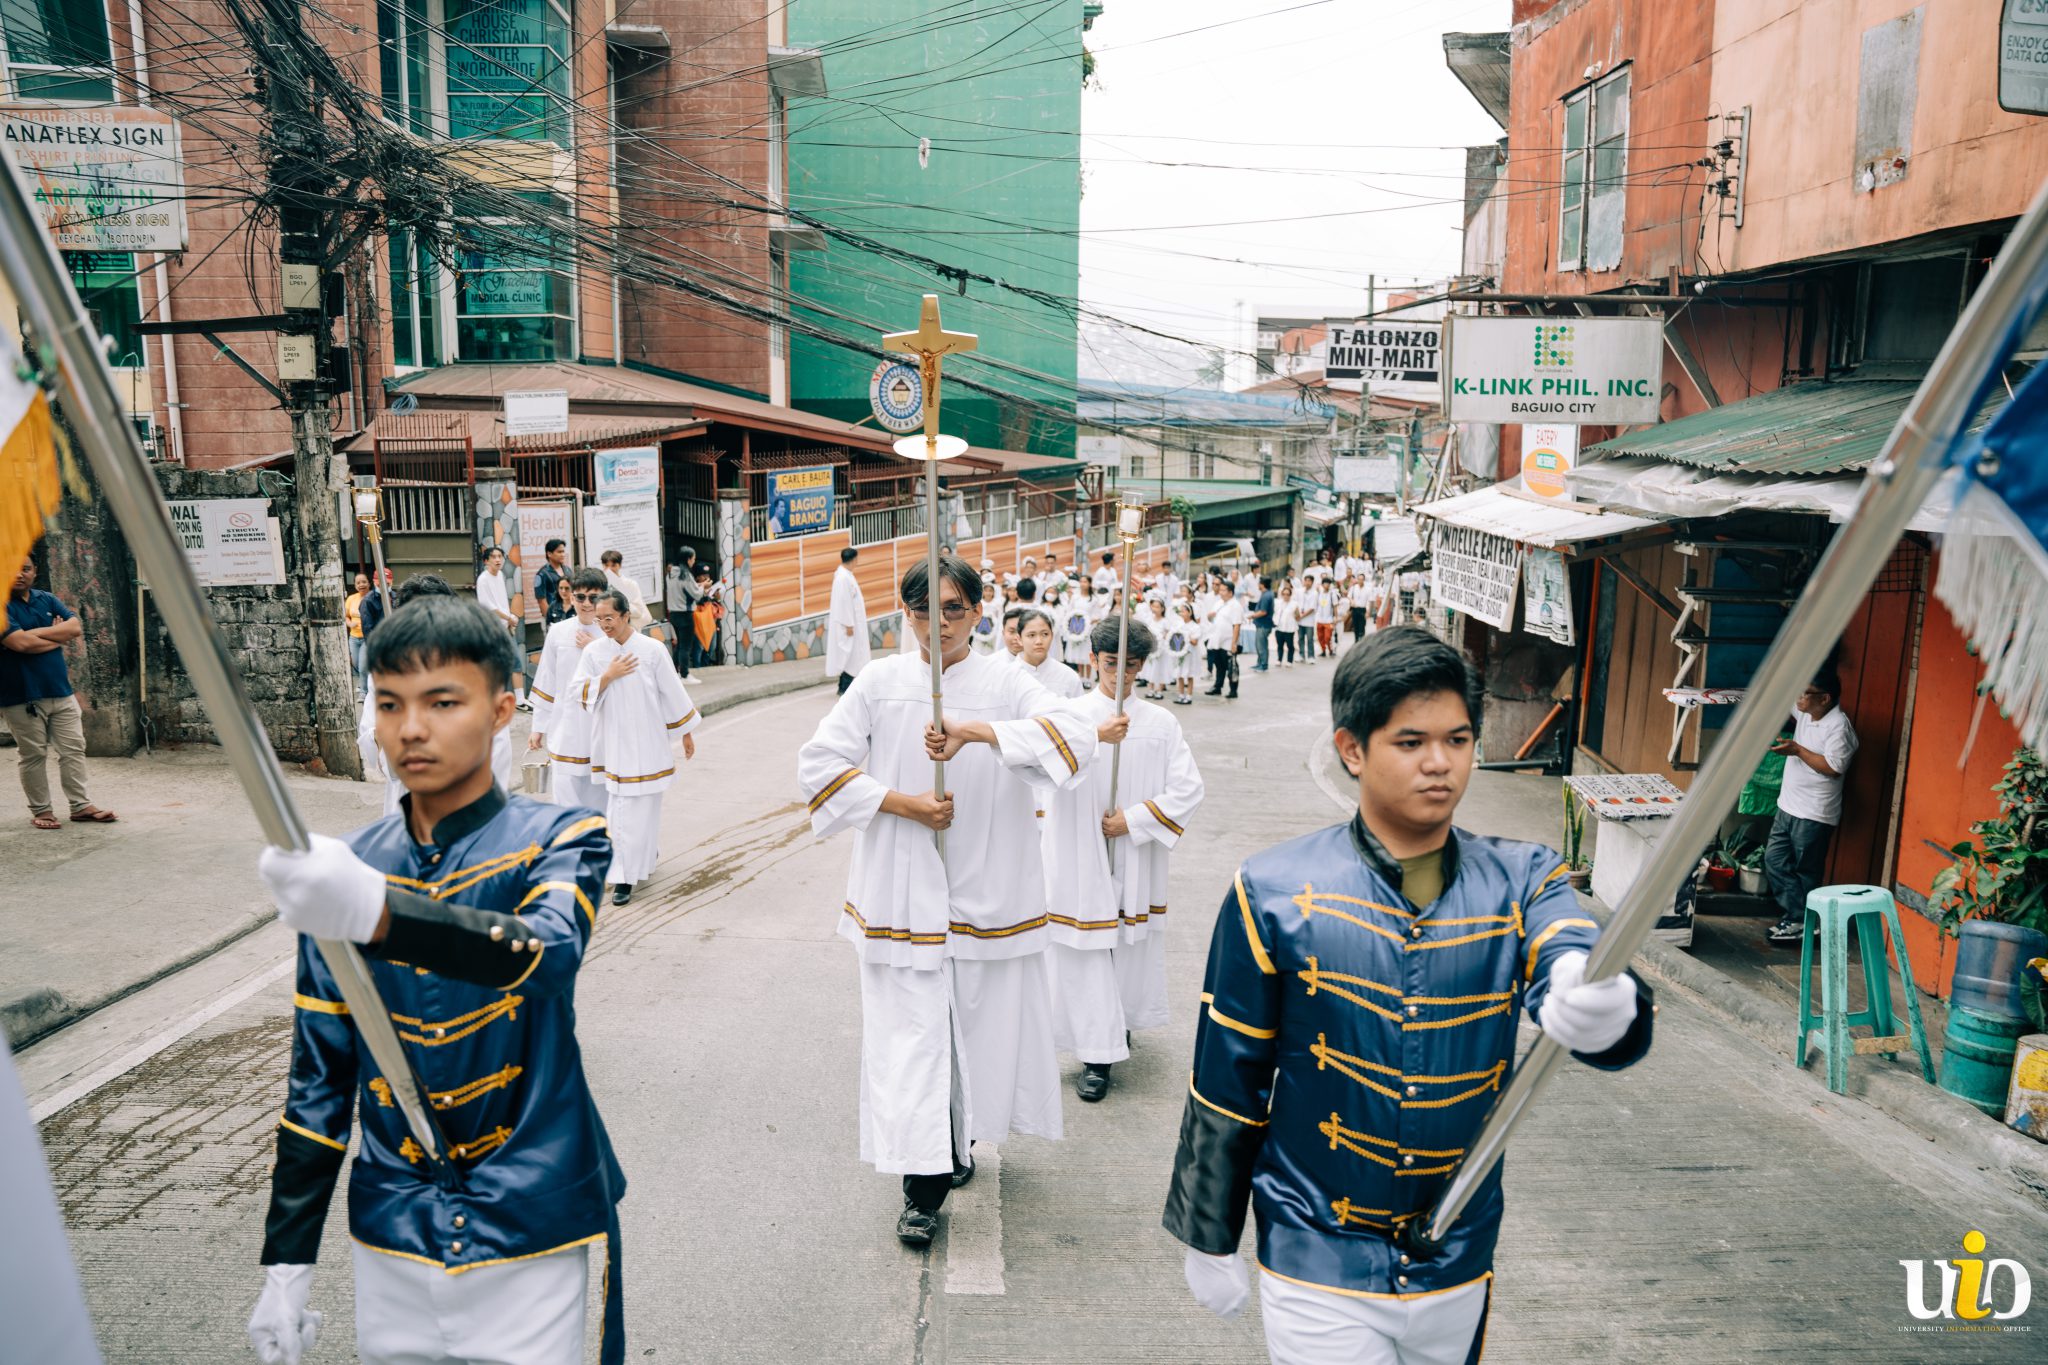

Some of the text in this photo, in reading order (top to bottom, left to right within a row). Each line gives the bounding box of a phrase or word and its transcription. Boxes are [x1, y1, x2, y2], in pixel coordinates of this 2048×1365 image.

[471, 14, 516, 28] HOUSE
[460, 29, 529, 44] CHRISTIAN
[2006, 34, 2041, 50] ENJOY
[472, 47, 519, 62] CENTER
[2006, 48, 2032, 62] DATA
[457, 62, 536, 77] WORLDWIDE
[112, 127, 164, 146] SIGN
[15, 150, 143, 163] T-SHIRT PRINTING
[62, 213, 131, 227] STAINLESS
[135, 213, 170, 227] SIGN
[471, 292, 542, 304] MEDICAL CLINIC
[1332, 328, 1438, 347] T-ALONZO
[1329, 349, 1438, 369] MINI-MART
[1359, 369, 1406, 381] 24/7
[1453, 377, 1654, 397] K-LINK PHIL. INC.
[1511, 402, 1597, 414] BAGUIO CITY
[1536, 429, 1559, 446] EATERY
[618, 467, 639, 476] Dental
[782, 474, 800, 485] CARL
[789, 495, 827, 512] BAGUIO
[520, 511, 566, 531] Herald
[789, 509, 828, 528] BRANCH
[185, 534, 205, 549] DITO!
[1481, 531, 1520, 569] EATERY
[1441, 552, 1456, 569] SERVE
[1456, 556, 1477, 575] BUDGET
[1444, 569, 1459, 586] SERVE
[1440, 584, 1447, 598] WE
[1447, 585, 1463, 604] SERVE
[976, 617, 994, 634] A
[1068, 614, 1086, 634] M
[1170, 634, 1186, 651] Y
